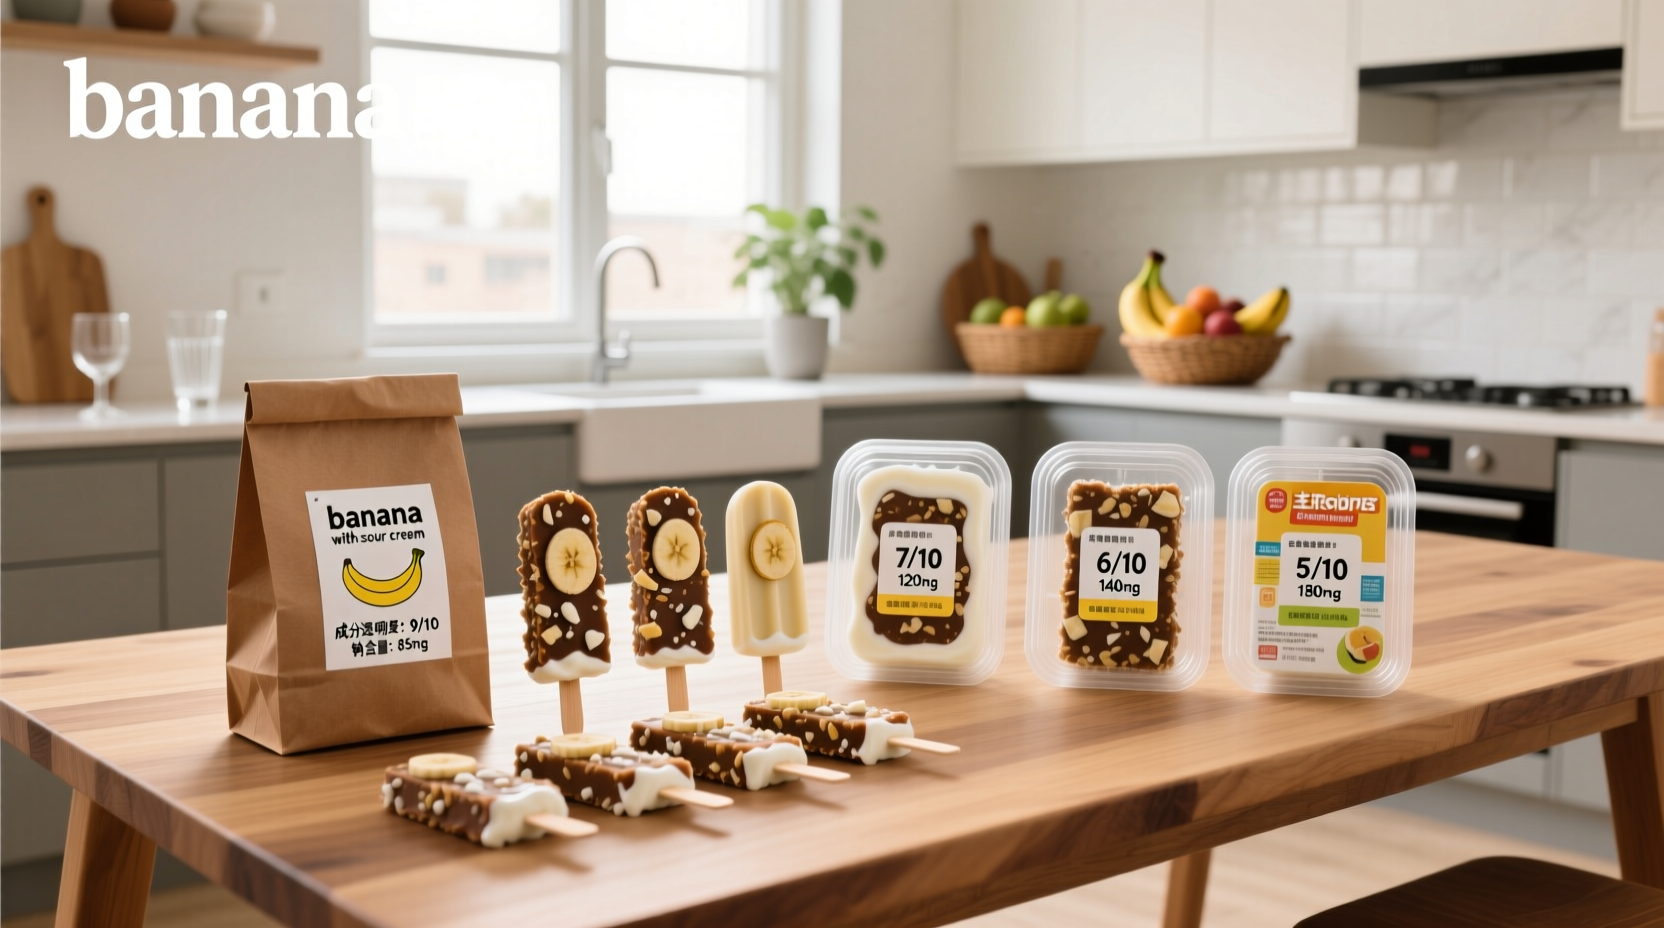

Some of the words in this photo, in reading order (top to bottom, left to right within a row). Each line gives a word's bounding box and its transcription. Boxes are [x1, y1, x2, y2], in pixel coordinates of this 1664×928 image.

[326, 505, 423, 530] banana
[331, 531, 358, 545] with
[360, 533, 387, 543] sour
[896, 546, 942, 569] 7/10
[1097, 551, 1147, 575] 6/10
[1296, 556, 1348, 581] 5/10
[898, 573, 938, 592] 120ng
[1099, 578, 1141, 597] 140ng
[409, 616, 439, 633] 9/10
